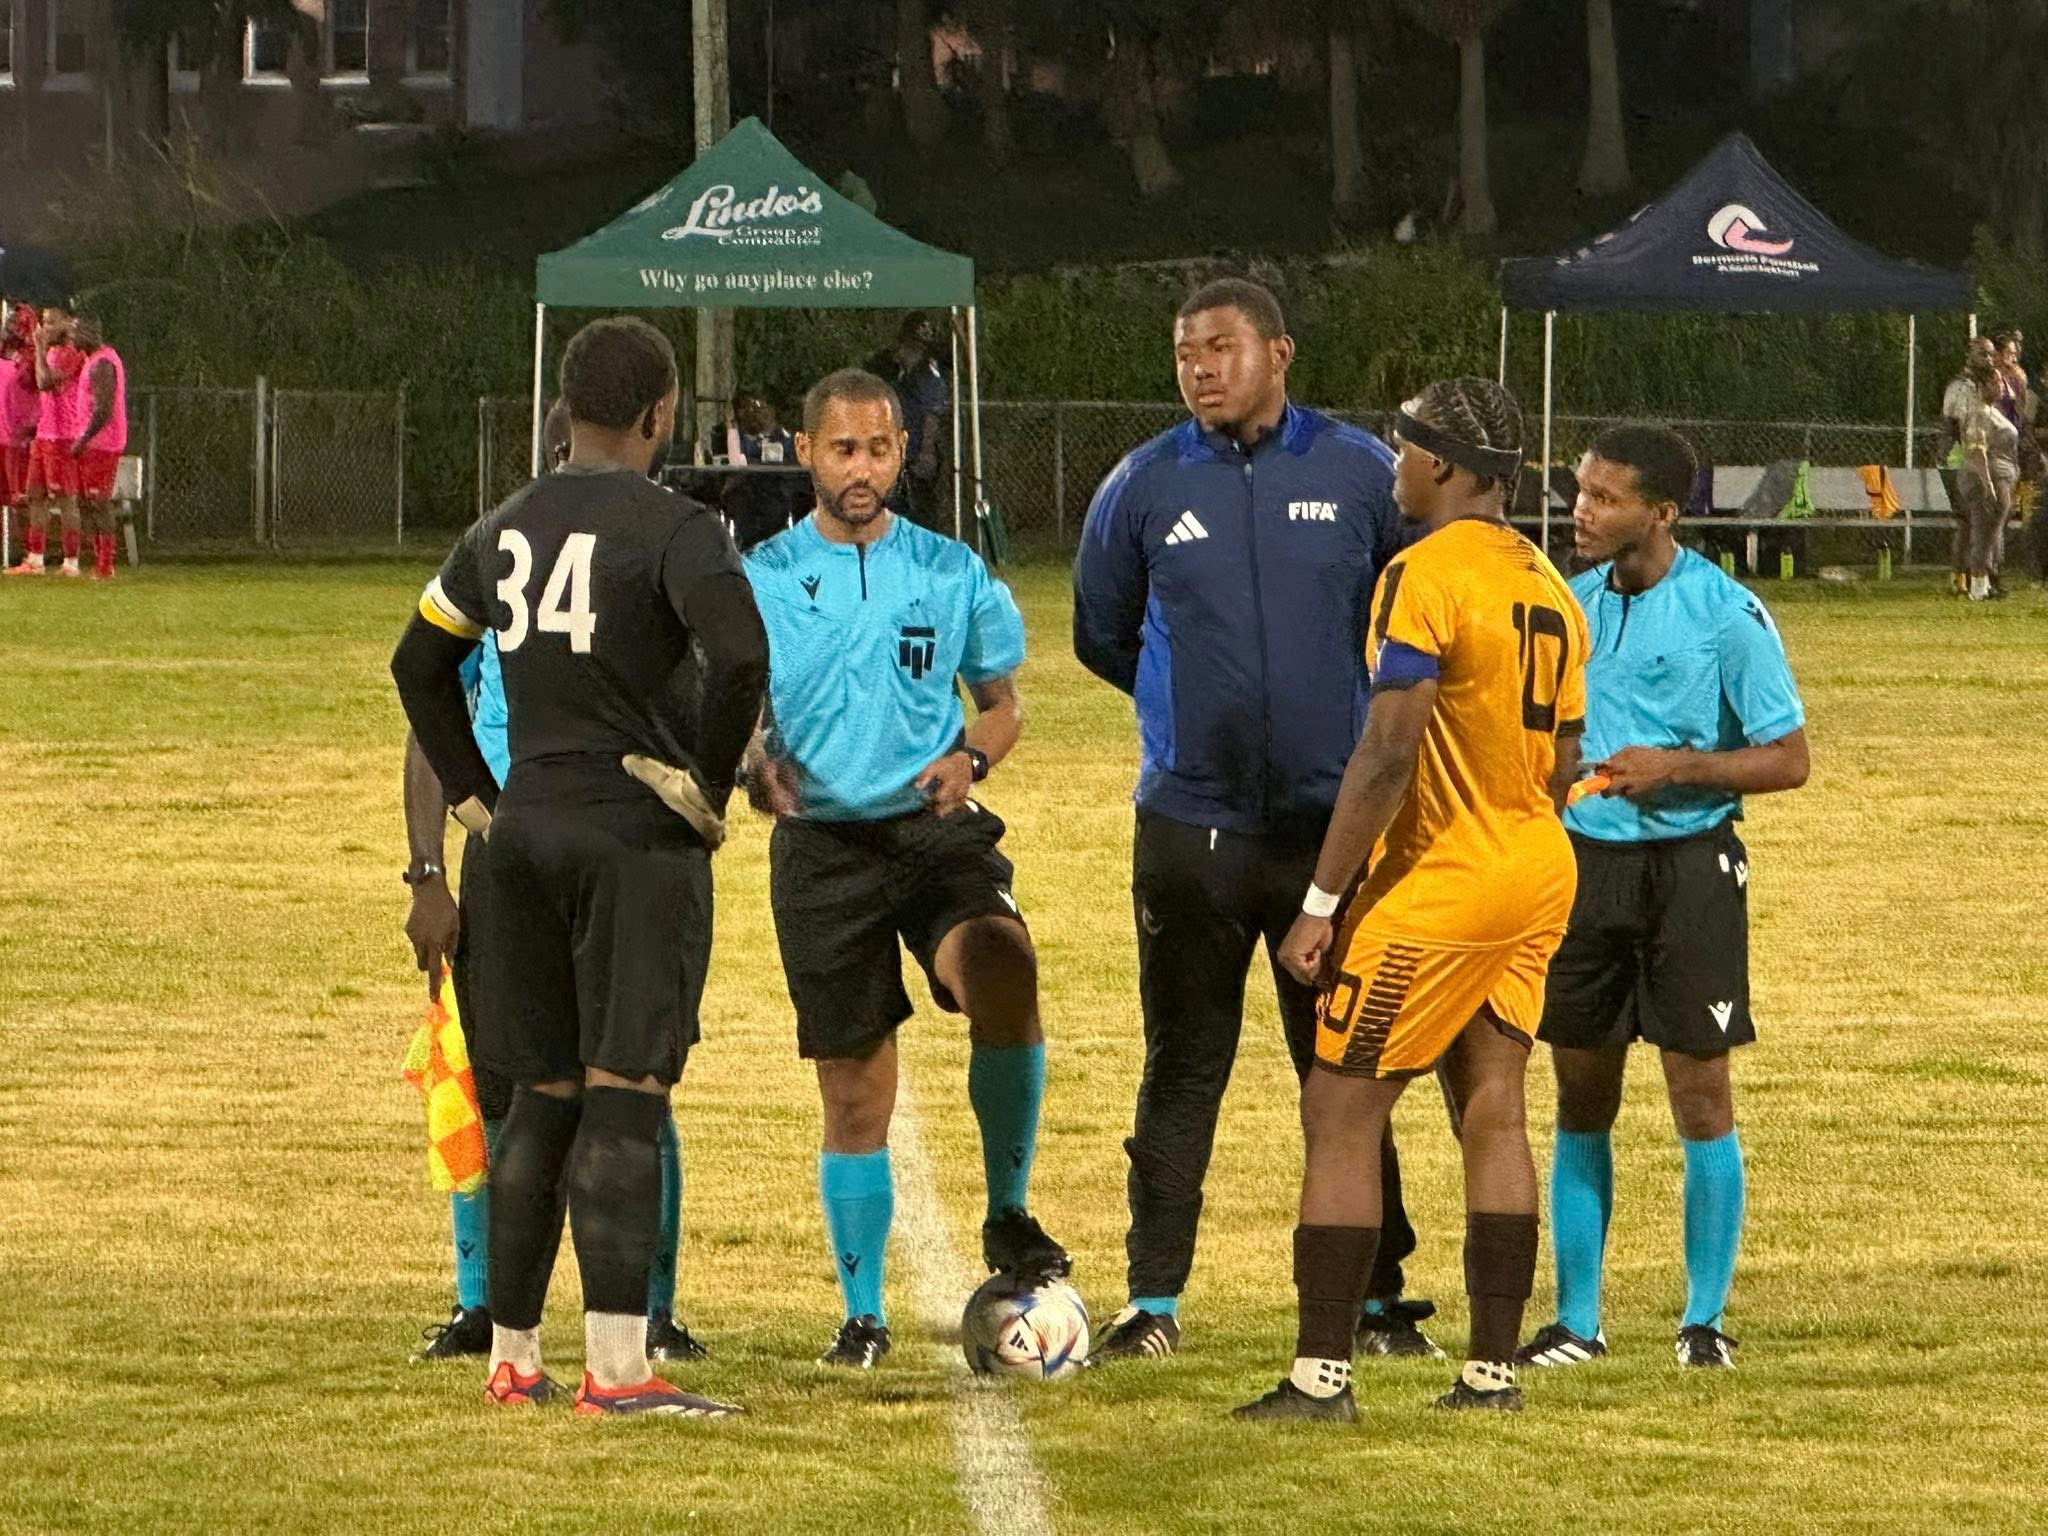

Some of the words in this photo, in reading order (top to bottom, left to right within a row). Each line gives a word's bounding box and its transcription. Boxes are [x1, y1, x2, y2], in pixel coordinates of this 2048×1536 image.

[661, 184, 823, 240] Lindo's
[639, 268, 688, 293] Why
[694, 272, 720, 292] go
[724, 269, 818, 293] anyplace
[822, 270, 874, 290] else?
[1288, 501, 1337, 522] FIFA
[496, 528, 597, 654] 34
[1512, 601, 1569, 733] 10
